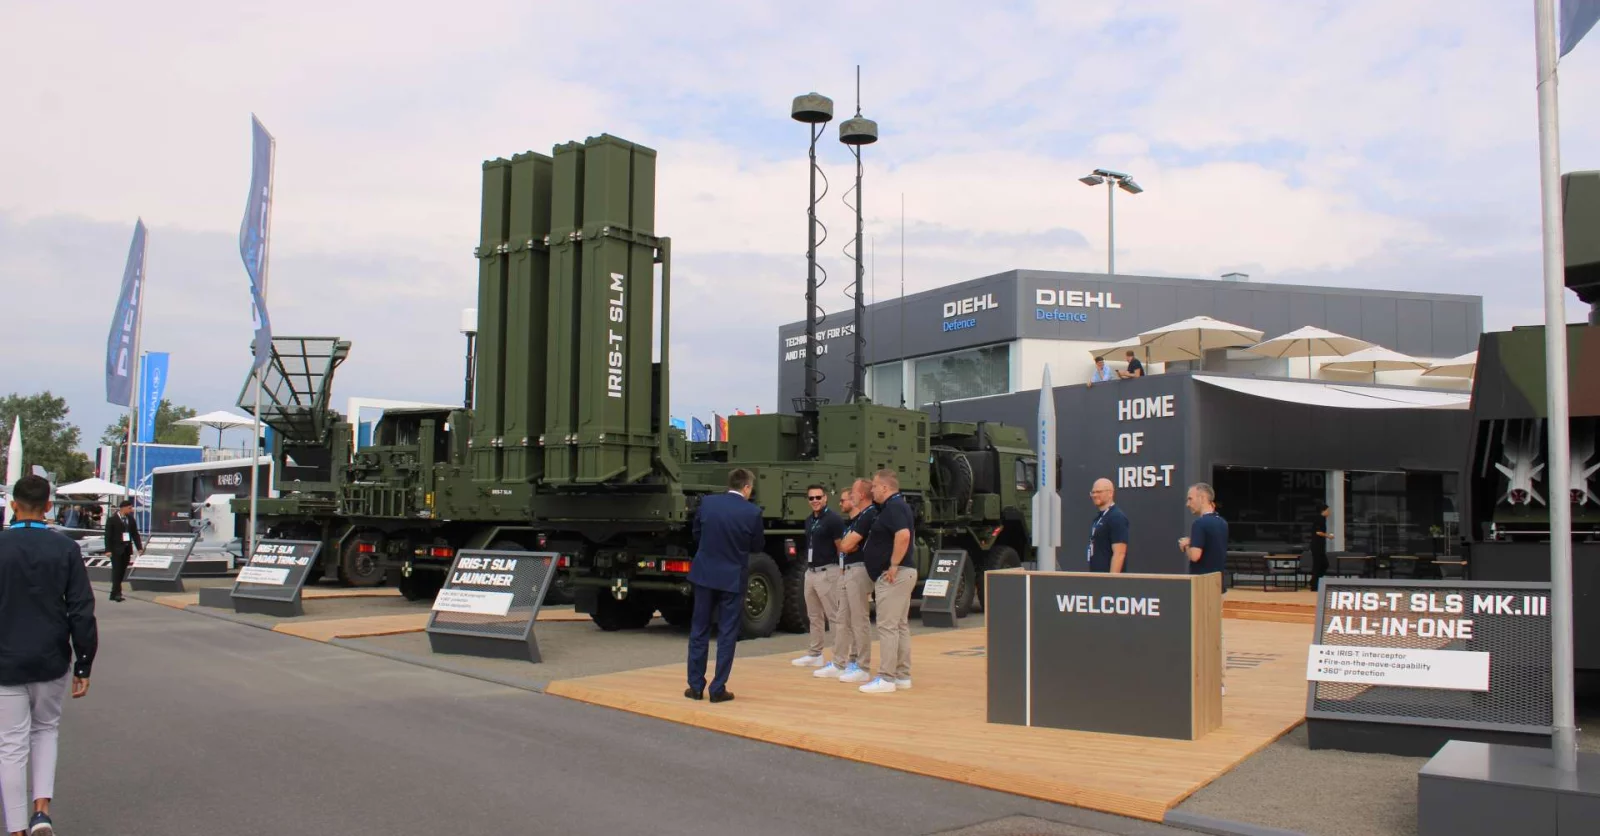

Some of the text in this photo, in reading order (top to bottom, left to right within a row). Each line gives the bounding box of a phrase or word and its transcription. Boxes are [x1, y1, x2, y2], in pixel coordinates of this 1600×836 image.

[943, 293, 999, 319] DIEHL
[1036, 289, 1122, 309] DIEHL
[1036, 308, 1087, 322] Defence
[827, 327, 841, 339] FOR
[943, 318, 976, 332] Defence
[608, 272, 624, 398] IRIS-T SLM
[785, 350, 798, 361] AND
[1118, 394, 1176, 421] HOME
[1118, 432, 1145, 455] OF
[1118, 464, 1175, 488] IRIS-T
[457, 557, 518, 571] IRIS-T SLM
[451, 572, 514, 586] LAUNCHER
[1056, 594, 1161, 616] WELCOME
[1330, 591, 1548, 616] IRIS-T SLS MK.III
[1327, 616, 1474, 639] ALL-IN-ONE
[1362, 650, 1407, 660] interceptor
[1323, 658, 1431, 671] Fire-on-the-move-capability
[1343, 669, 1385, 677] protection
